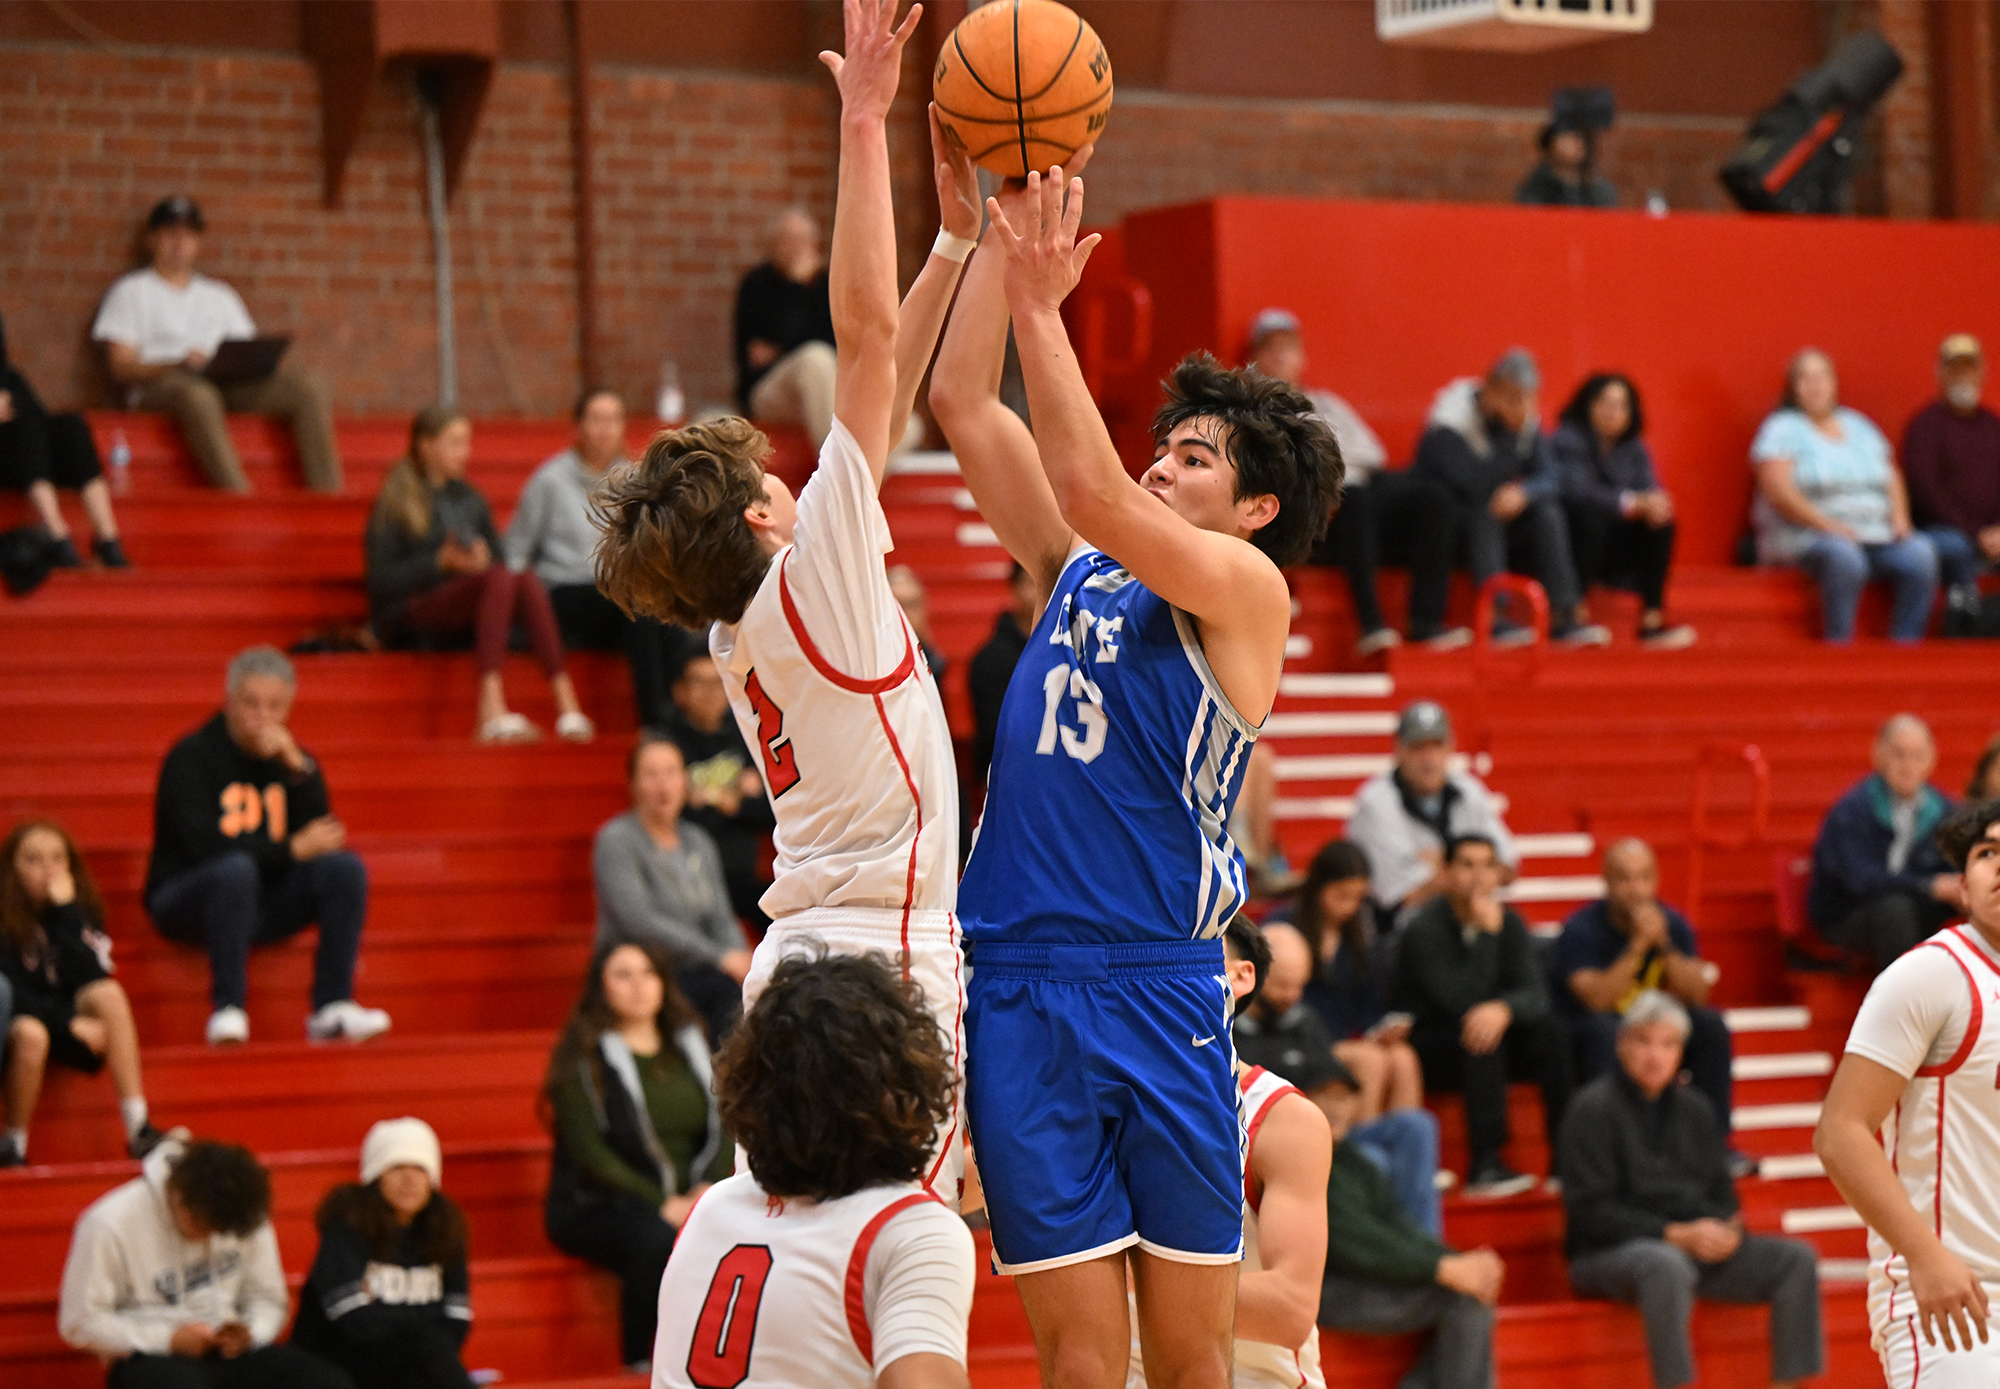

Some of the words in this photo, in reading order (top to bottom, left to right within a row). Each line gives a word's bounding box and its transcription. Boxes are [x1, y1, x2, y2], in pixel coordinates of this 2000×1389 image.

[744, 666, 801, 801] 2
[1035, 663, 1109, 764] 13
[686, 1243, 774, 1389] 0
